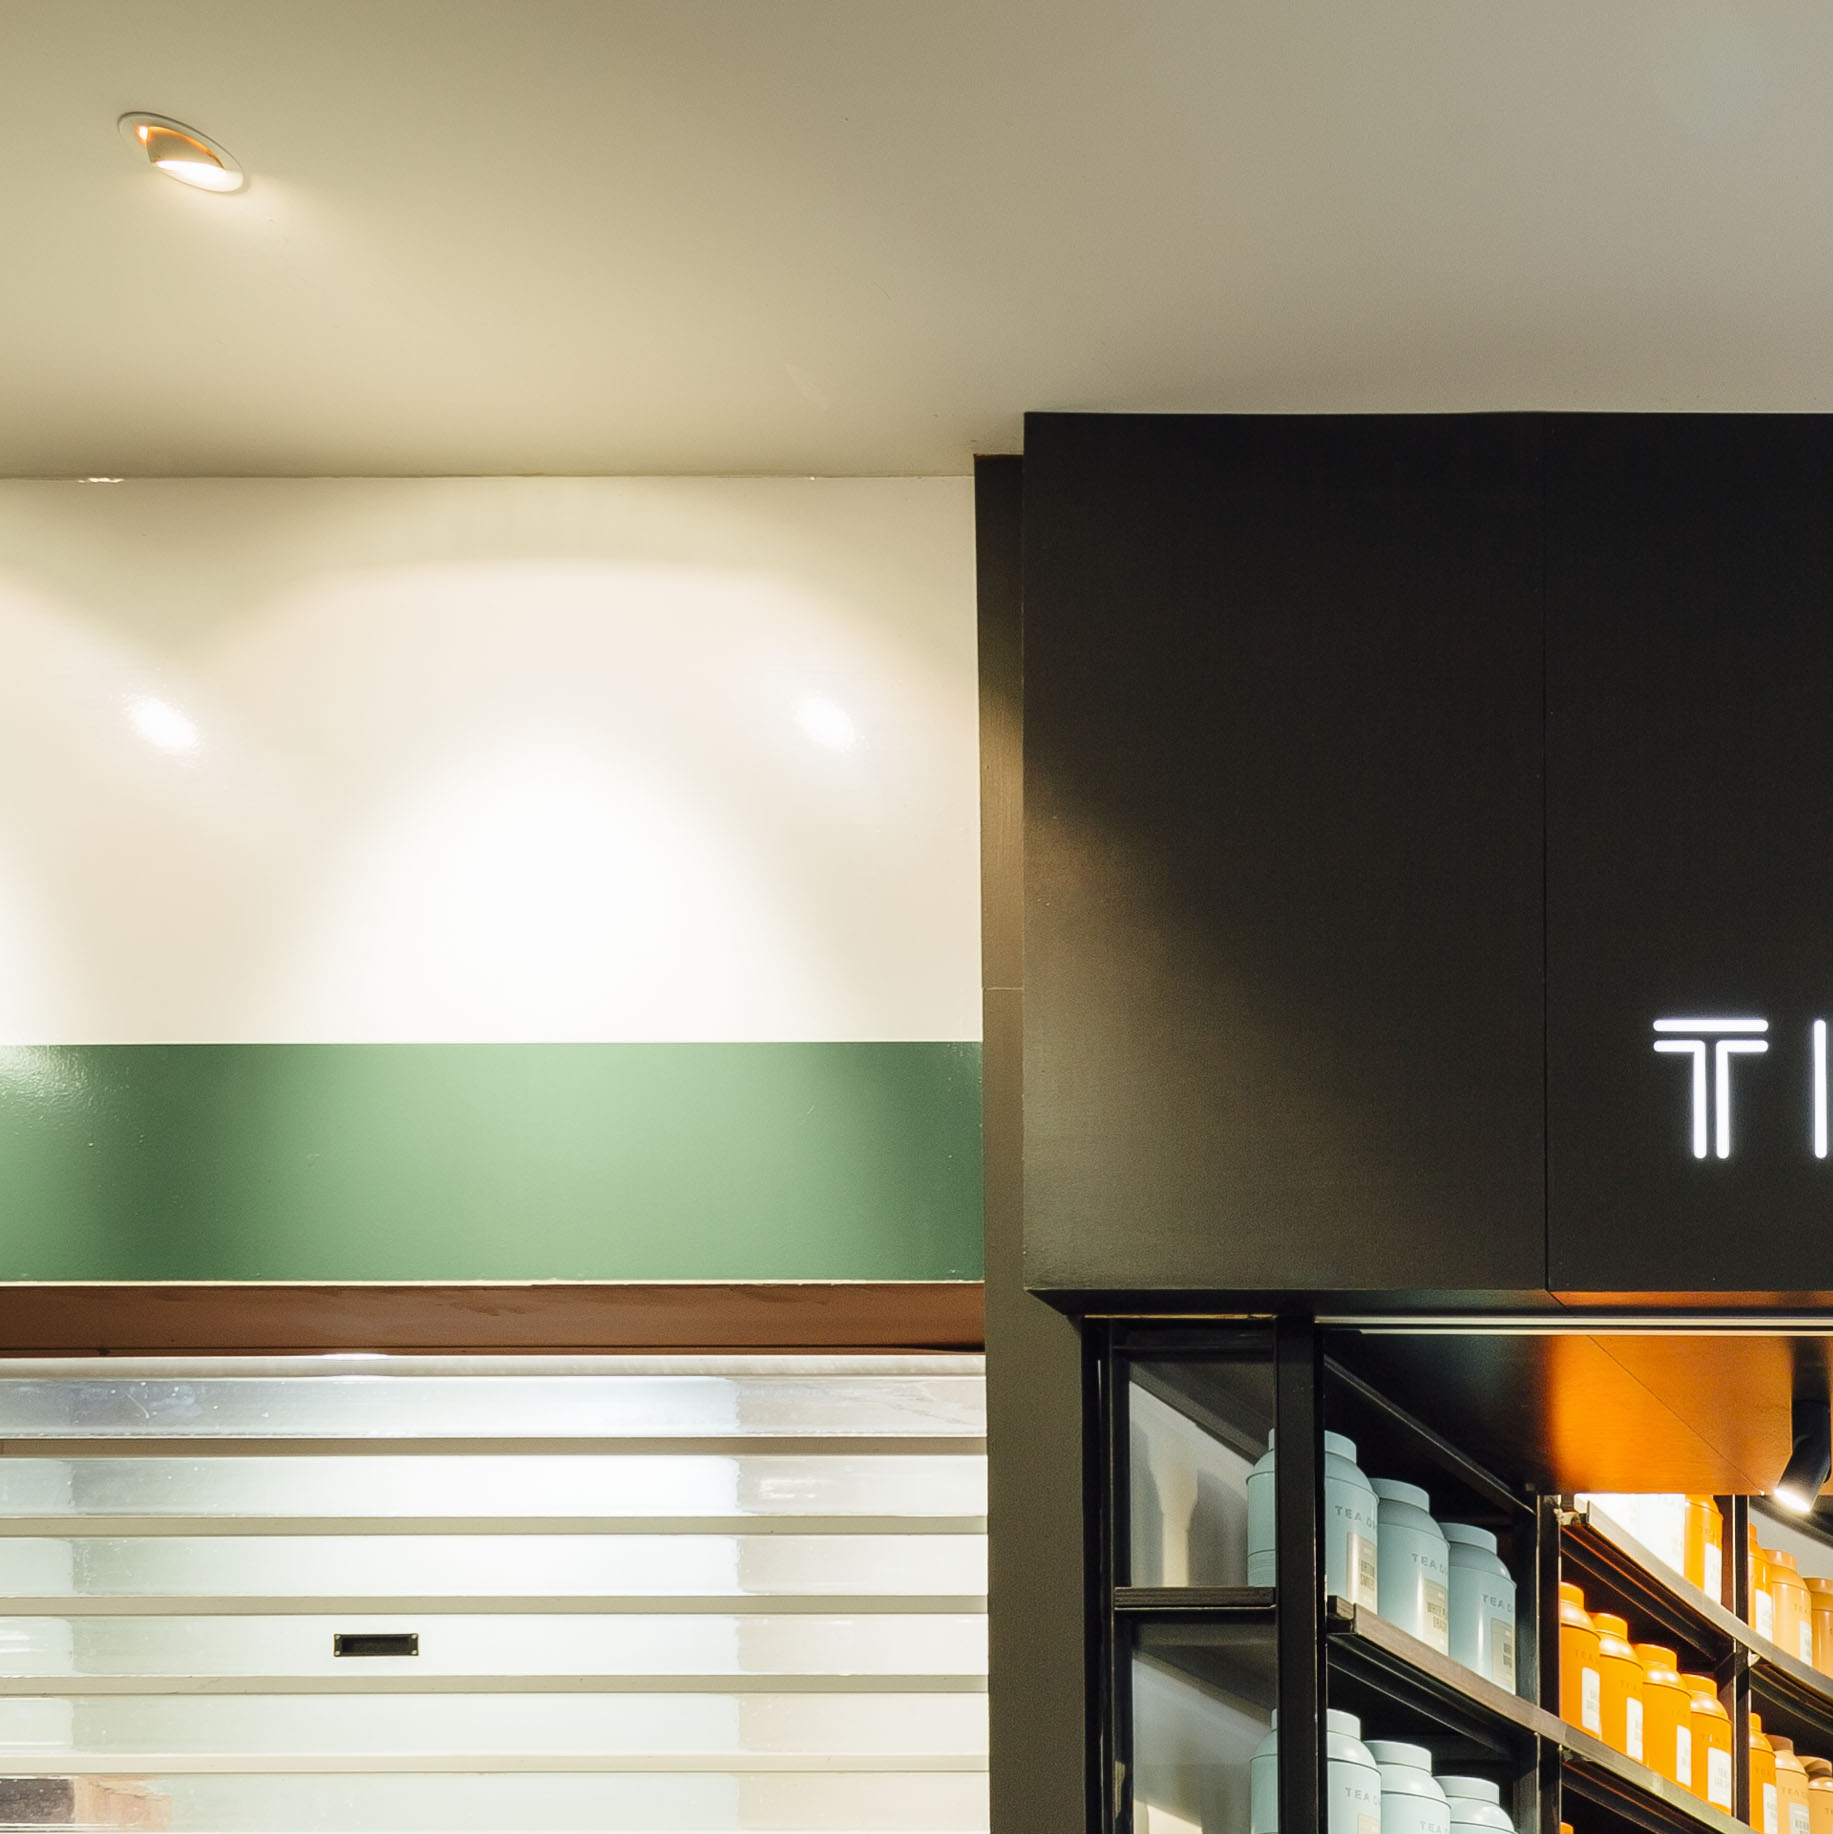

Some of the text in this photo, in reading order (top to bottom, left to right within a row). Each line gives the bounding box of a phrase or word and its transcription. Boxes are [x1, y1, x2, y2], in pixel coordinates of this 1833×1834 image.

[1335, 1505, 1361, 1521] TEA
[1411, 1552, 1437, 1568] TEA
[1482, 1593, 1504, 1609] TEA
[1345, 1787, 1370, 1801] TEA
[1420, 1820, 1442, 1833] TEA
